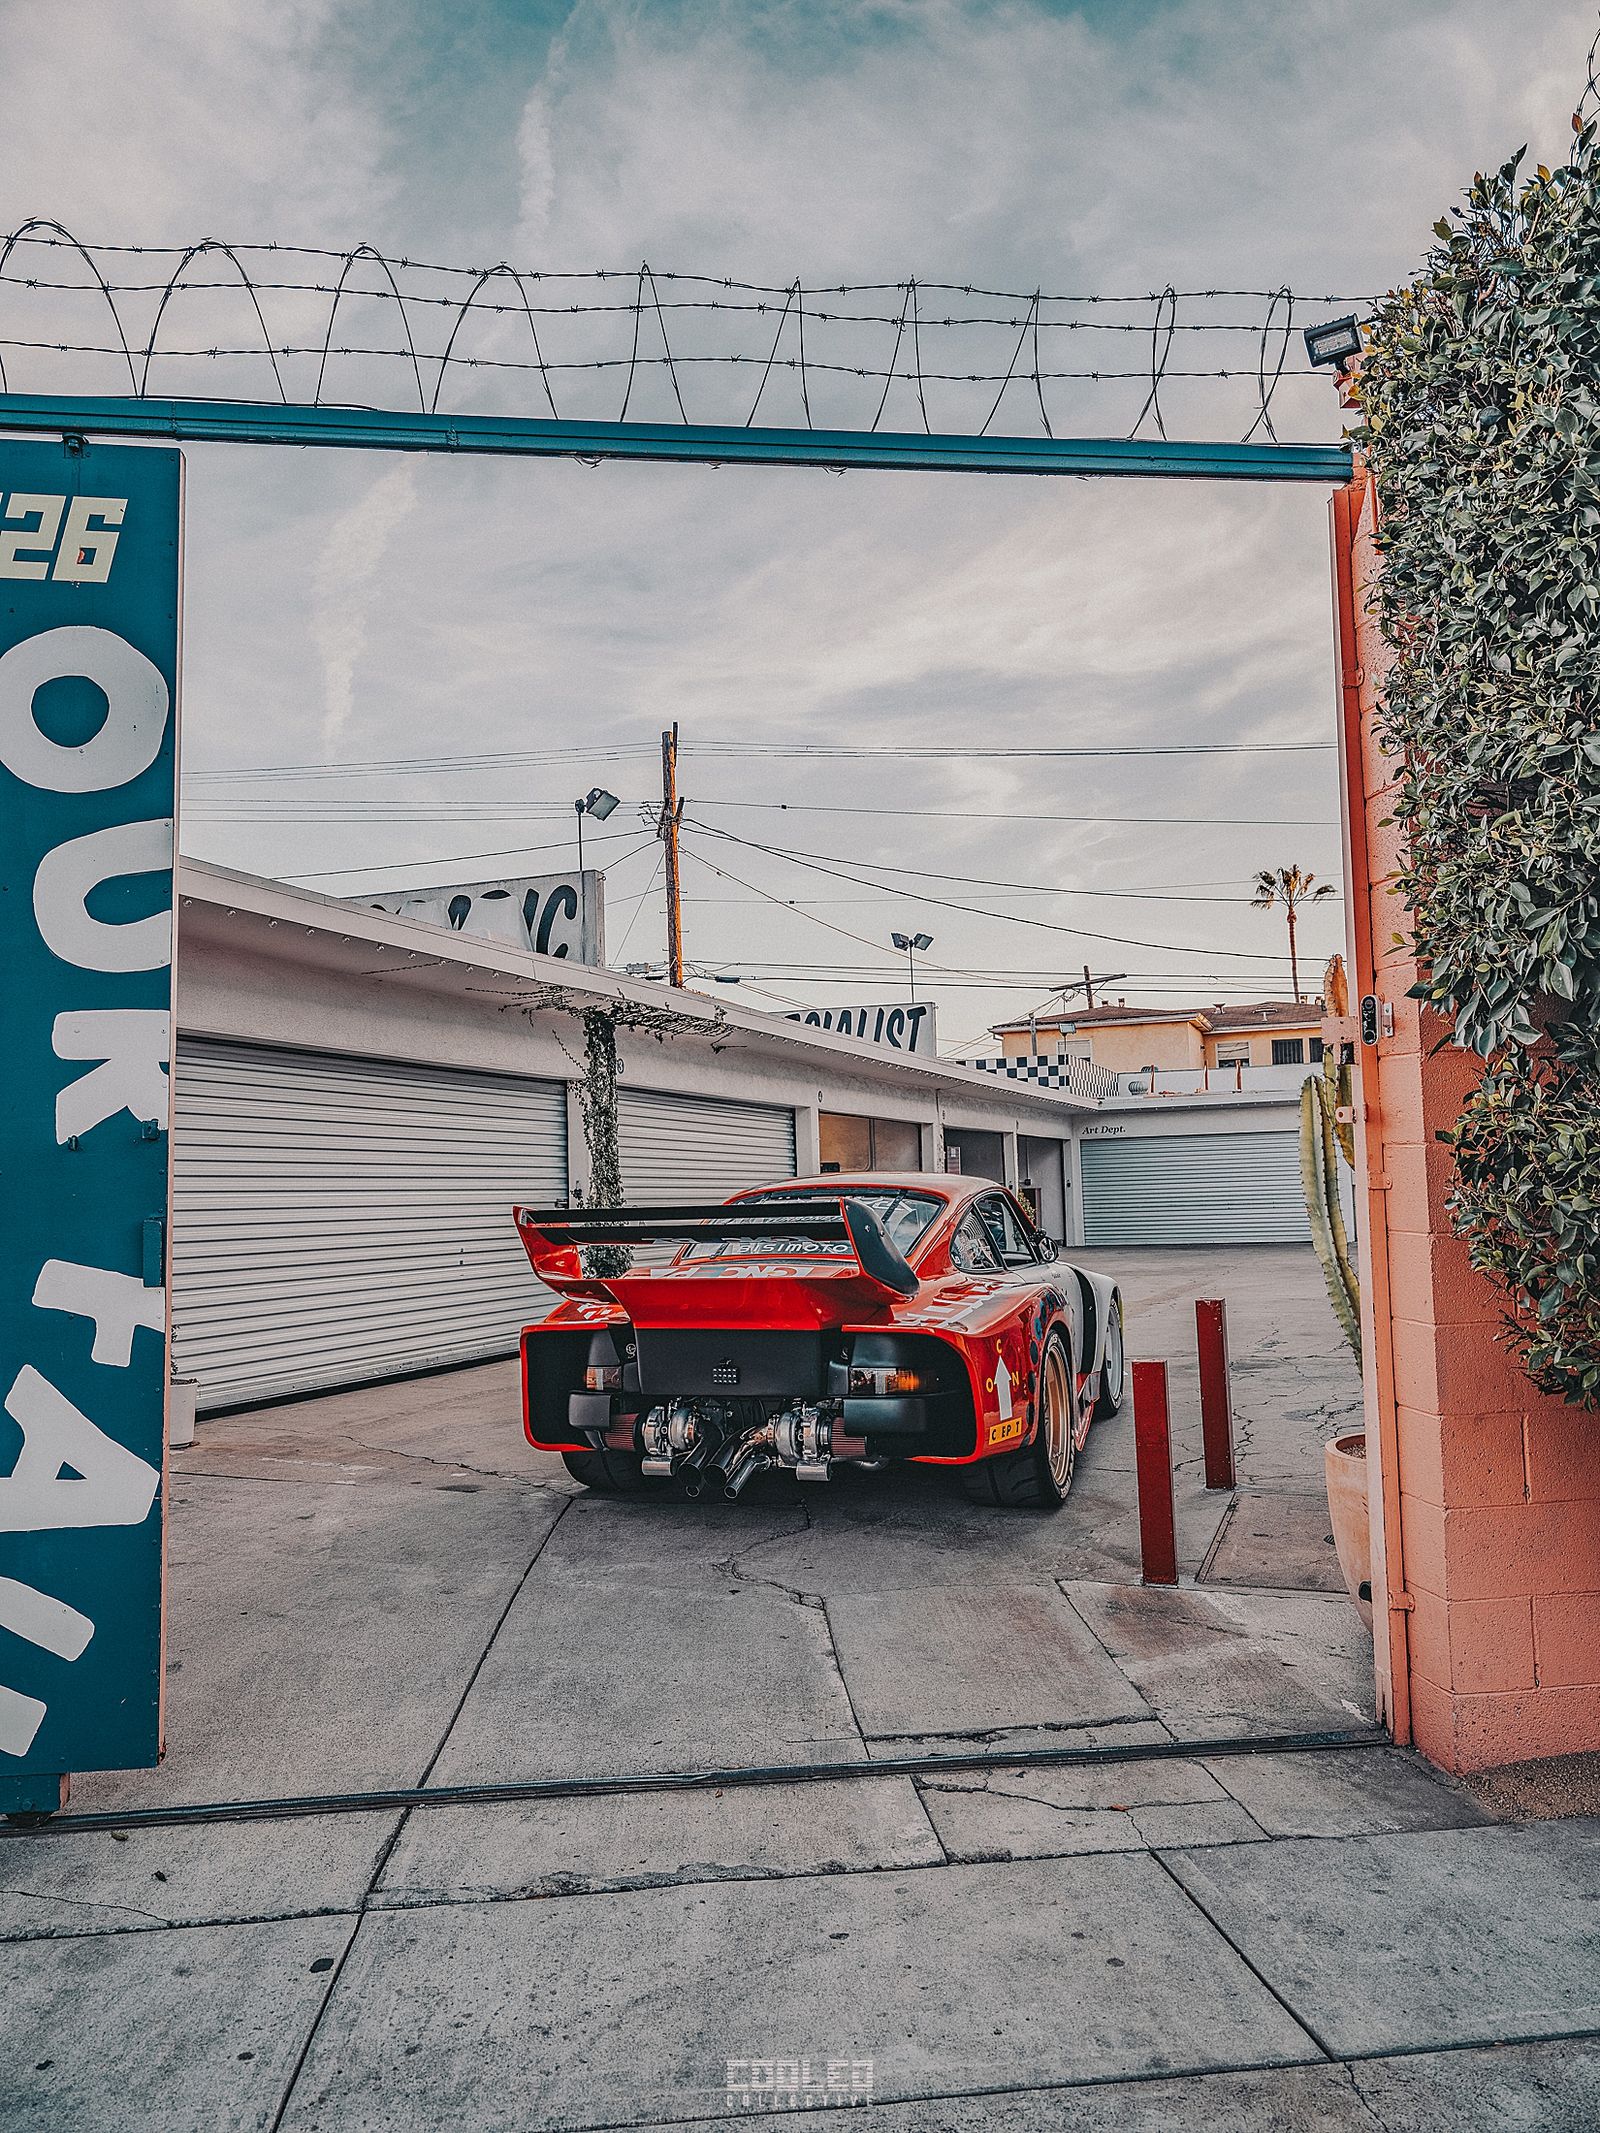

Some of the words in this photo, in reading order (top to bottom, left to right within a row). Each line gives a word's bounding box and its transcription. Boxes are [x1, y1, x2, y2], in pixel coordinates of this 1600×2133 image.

[0, 492, 128, 583] 26
[1082, 1126, 1099, 1135] Art
[1100, 1125, 1126, 1135] Dept.
